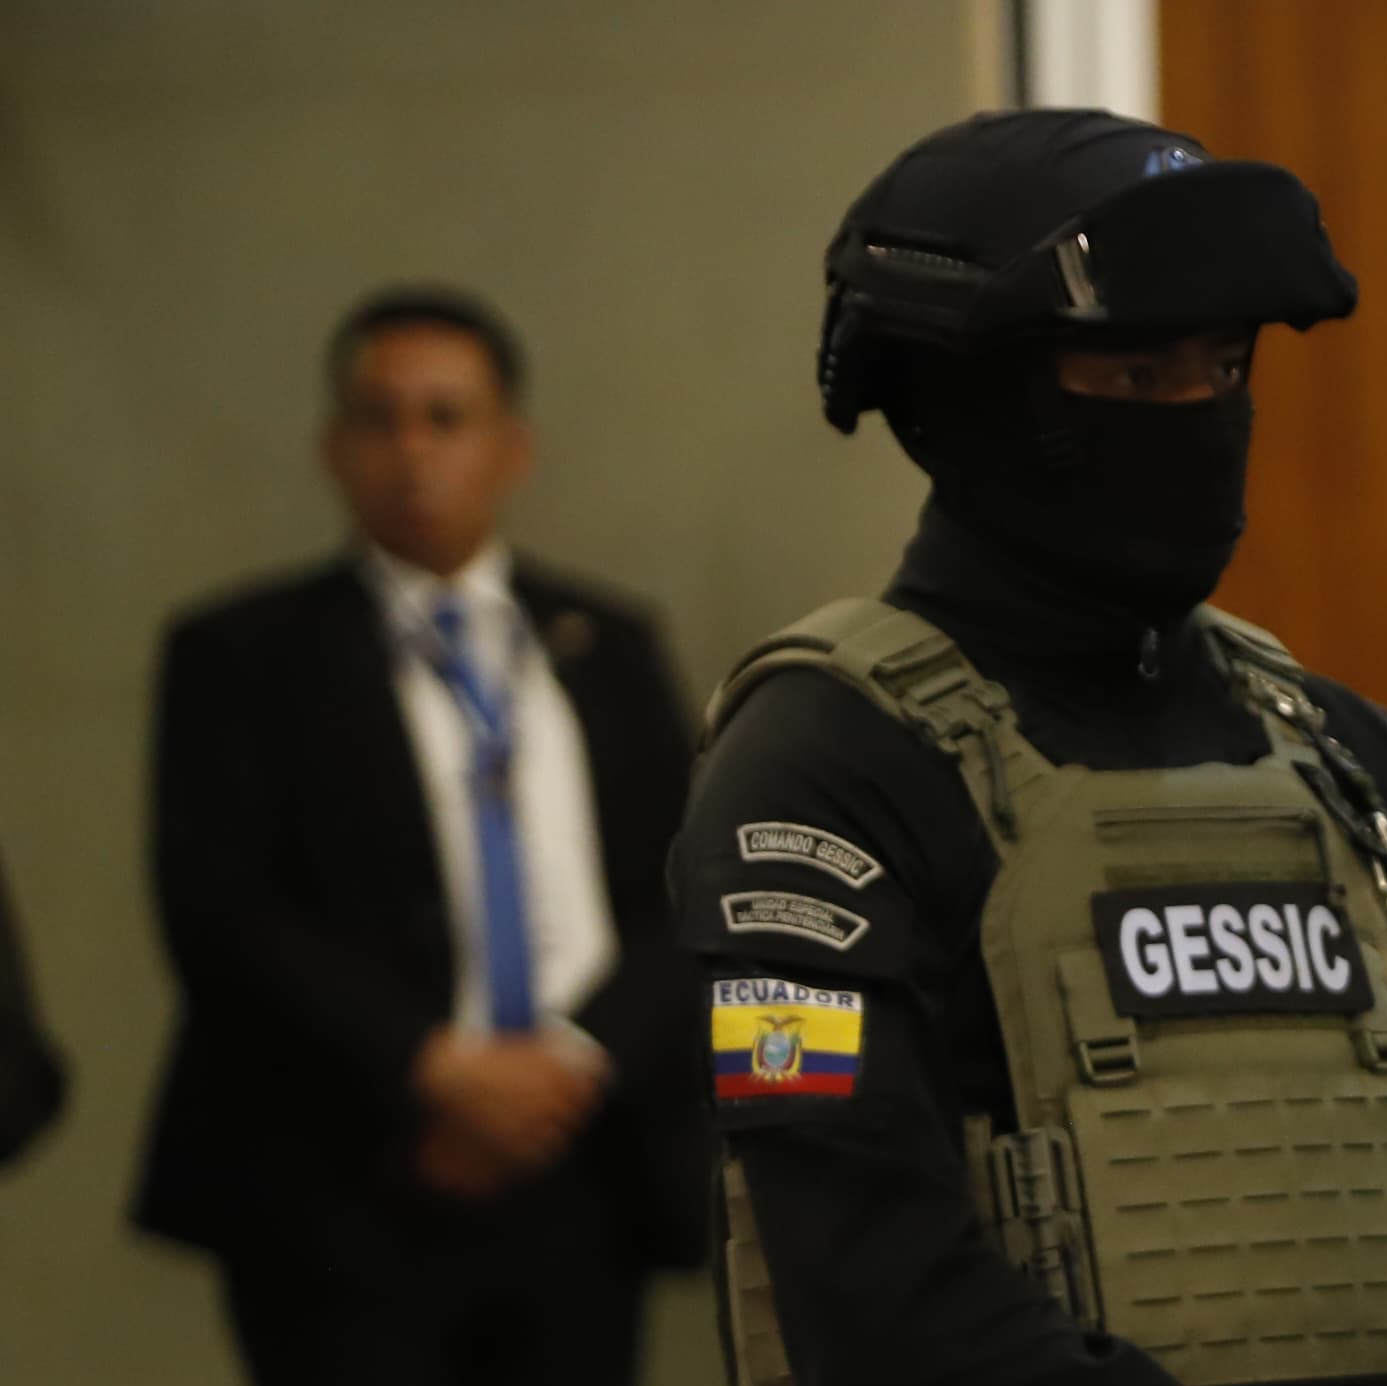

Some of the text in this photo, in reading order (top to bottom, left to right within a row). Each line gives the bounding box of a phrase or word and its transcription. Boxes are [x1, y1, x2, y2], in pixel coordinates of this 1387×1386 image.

[751, 830, 865, 875] COMANDO GESSIC
[1120, 903, 1351, 997] GESSIC
[719, 981, 854, 1007] ECUADOR
